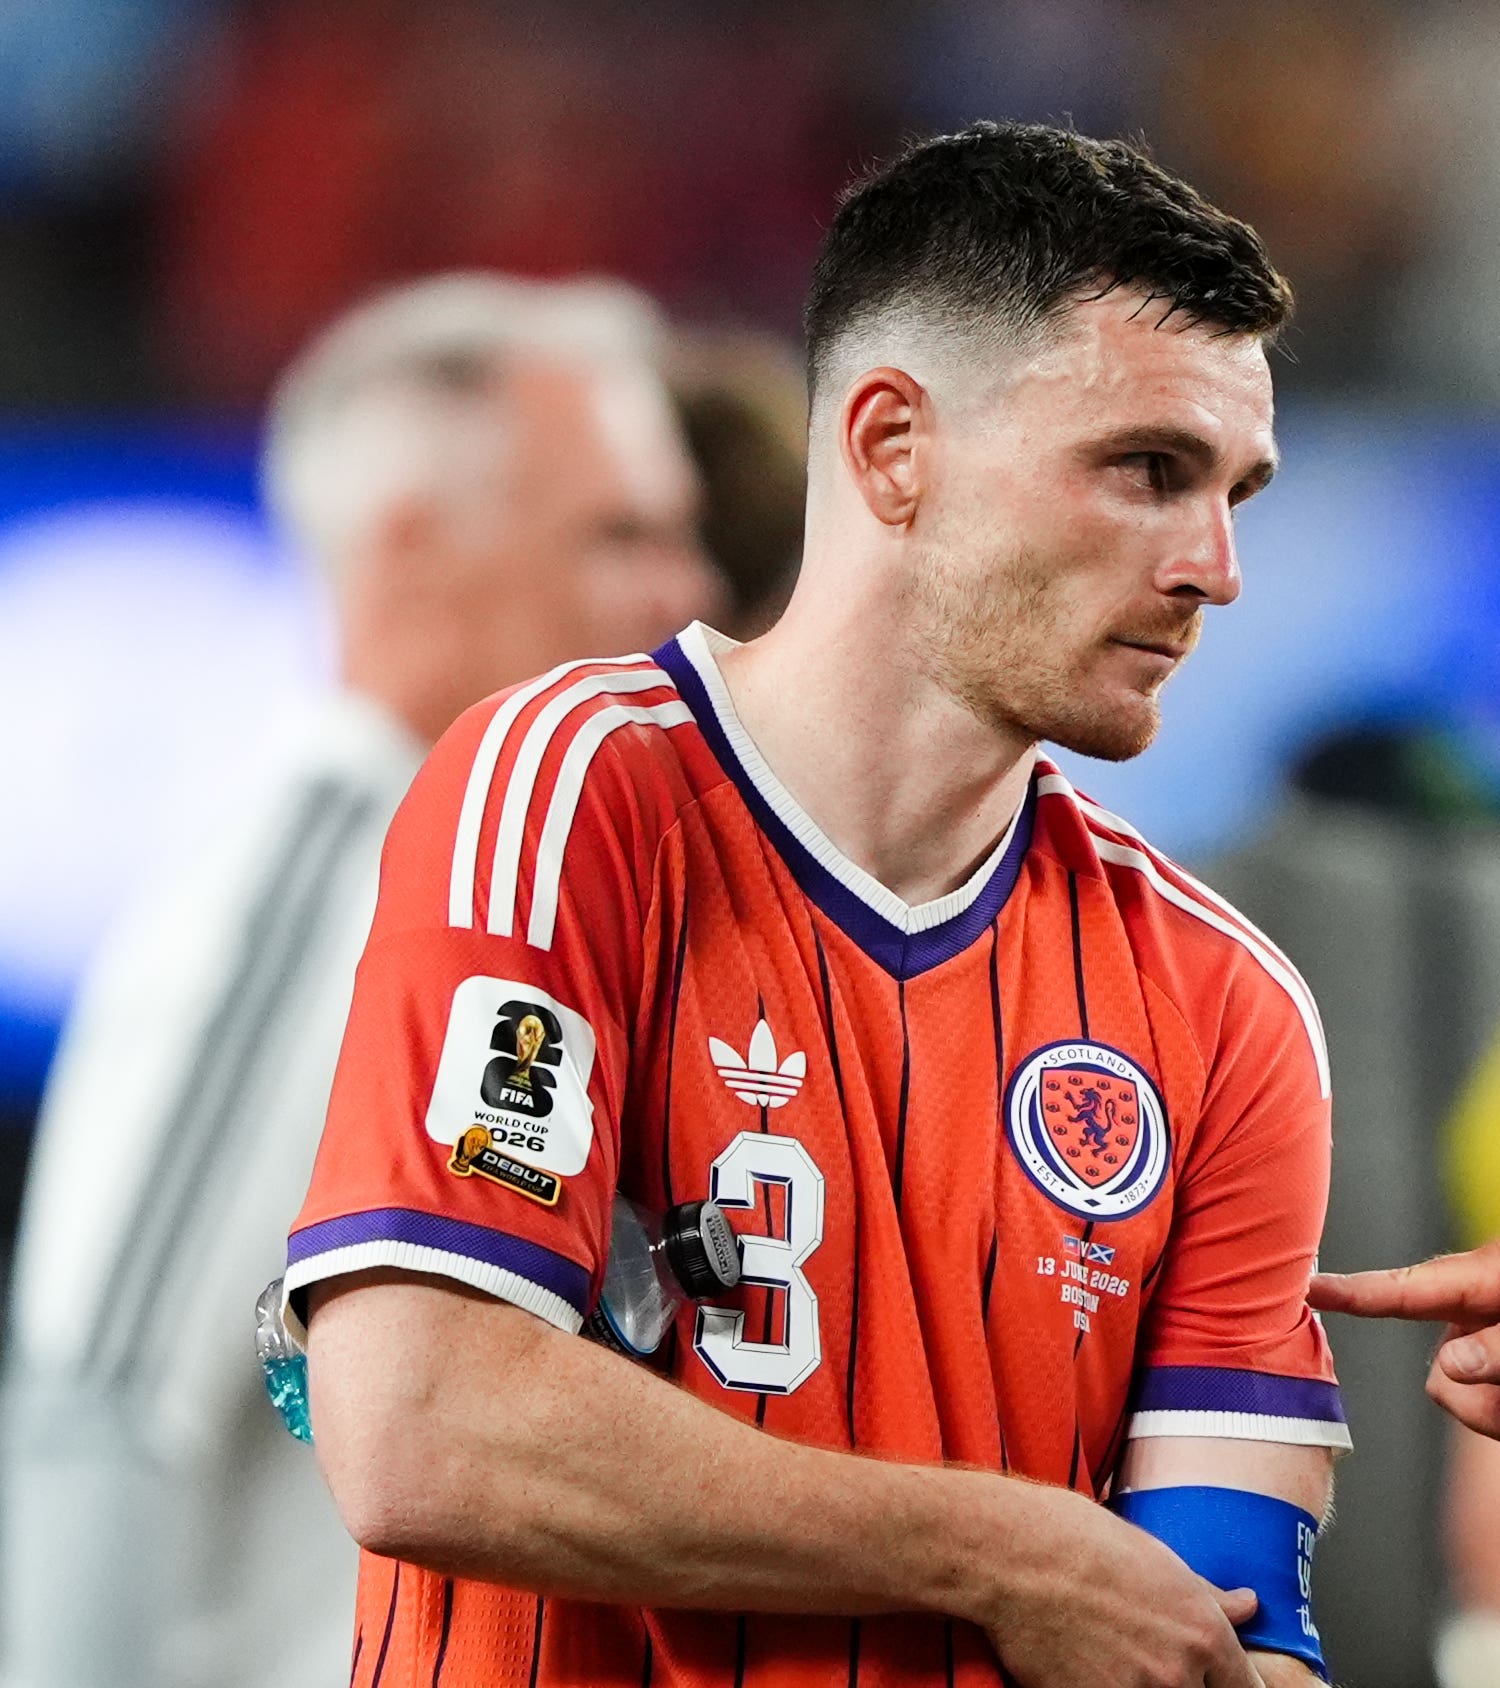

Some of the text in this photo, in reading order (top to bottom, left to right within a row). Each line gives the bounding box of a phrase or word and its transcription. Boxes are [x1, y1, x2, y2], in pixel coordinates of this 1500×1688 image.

[1049, 1048, 1126, 1074] SCOTLAND
[500, 1088, 534, 1108] FIFA
[475, 1111, 549, 1135] WORLD CUP
[472, 1123, 546, 1153] 026
[483, 1151, 552, 1187] DEBUT
[1036, 1165, 1147, 1204] EST 1873
[693, 1130, 825, 1395] 3
[1037, 1256, 1129, 1297] 13 JUNE 2026
[1061, 1284, 1099, 1313] BOSTON
[1073, 1310, 1091, 1333] USA
